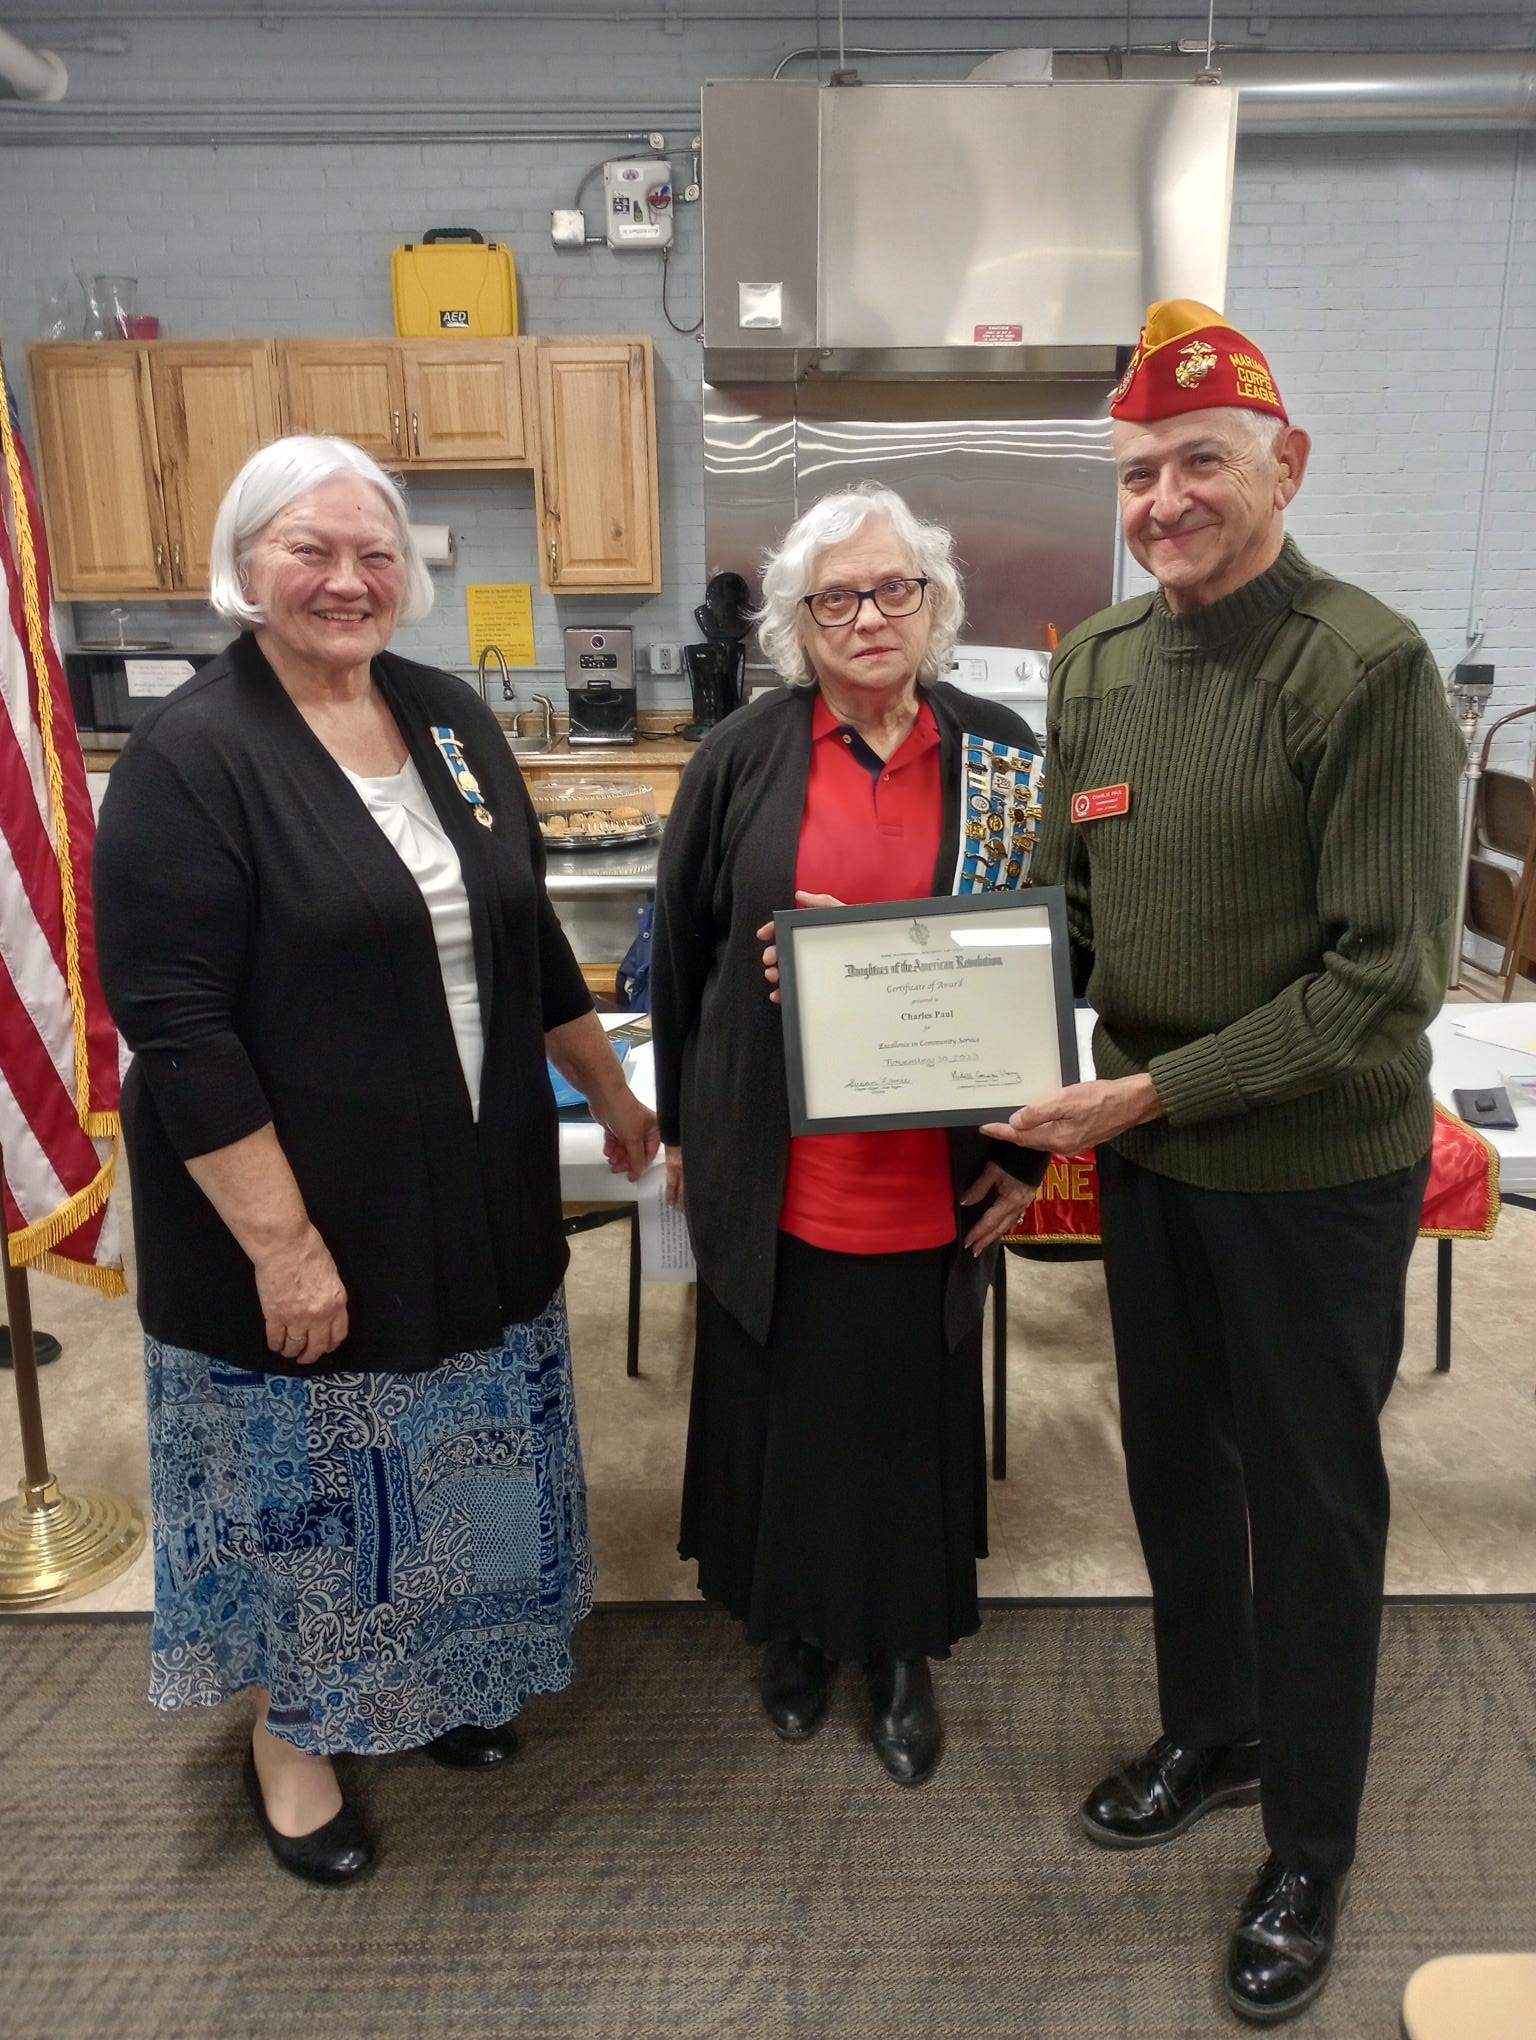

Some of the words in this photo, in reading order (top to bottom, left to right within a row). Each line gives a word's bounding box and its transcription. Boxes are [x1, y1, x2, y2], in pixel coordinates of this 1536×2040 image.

[443, 311, 467, 321] AED
[1229, 352, 1271, 381] MARINE
[1237, 367, 1272, 391] CORPS
[1236, 380, 1280, 407] LEAGUE
[844, 962, 889, 980] Daughters
[890, 961, 901, 974] of
[900, 960, 913, 974] the
[912, 958, 954, 972] American
[886, 983, 926, 995] Certificate
[927, 980, 936, 993] of
[938, 976, 964, 989] Award
[901, 1011, 932, 1021] Charles
[935, 1010, 954, 1019] Paul
[919, 1038, 957, 1047] Community
